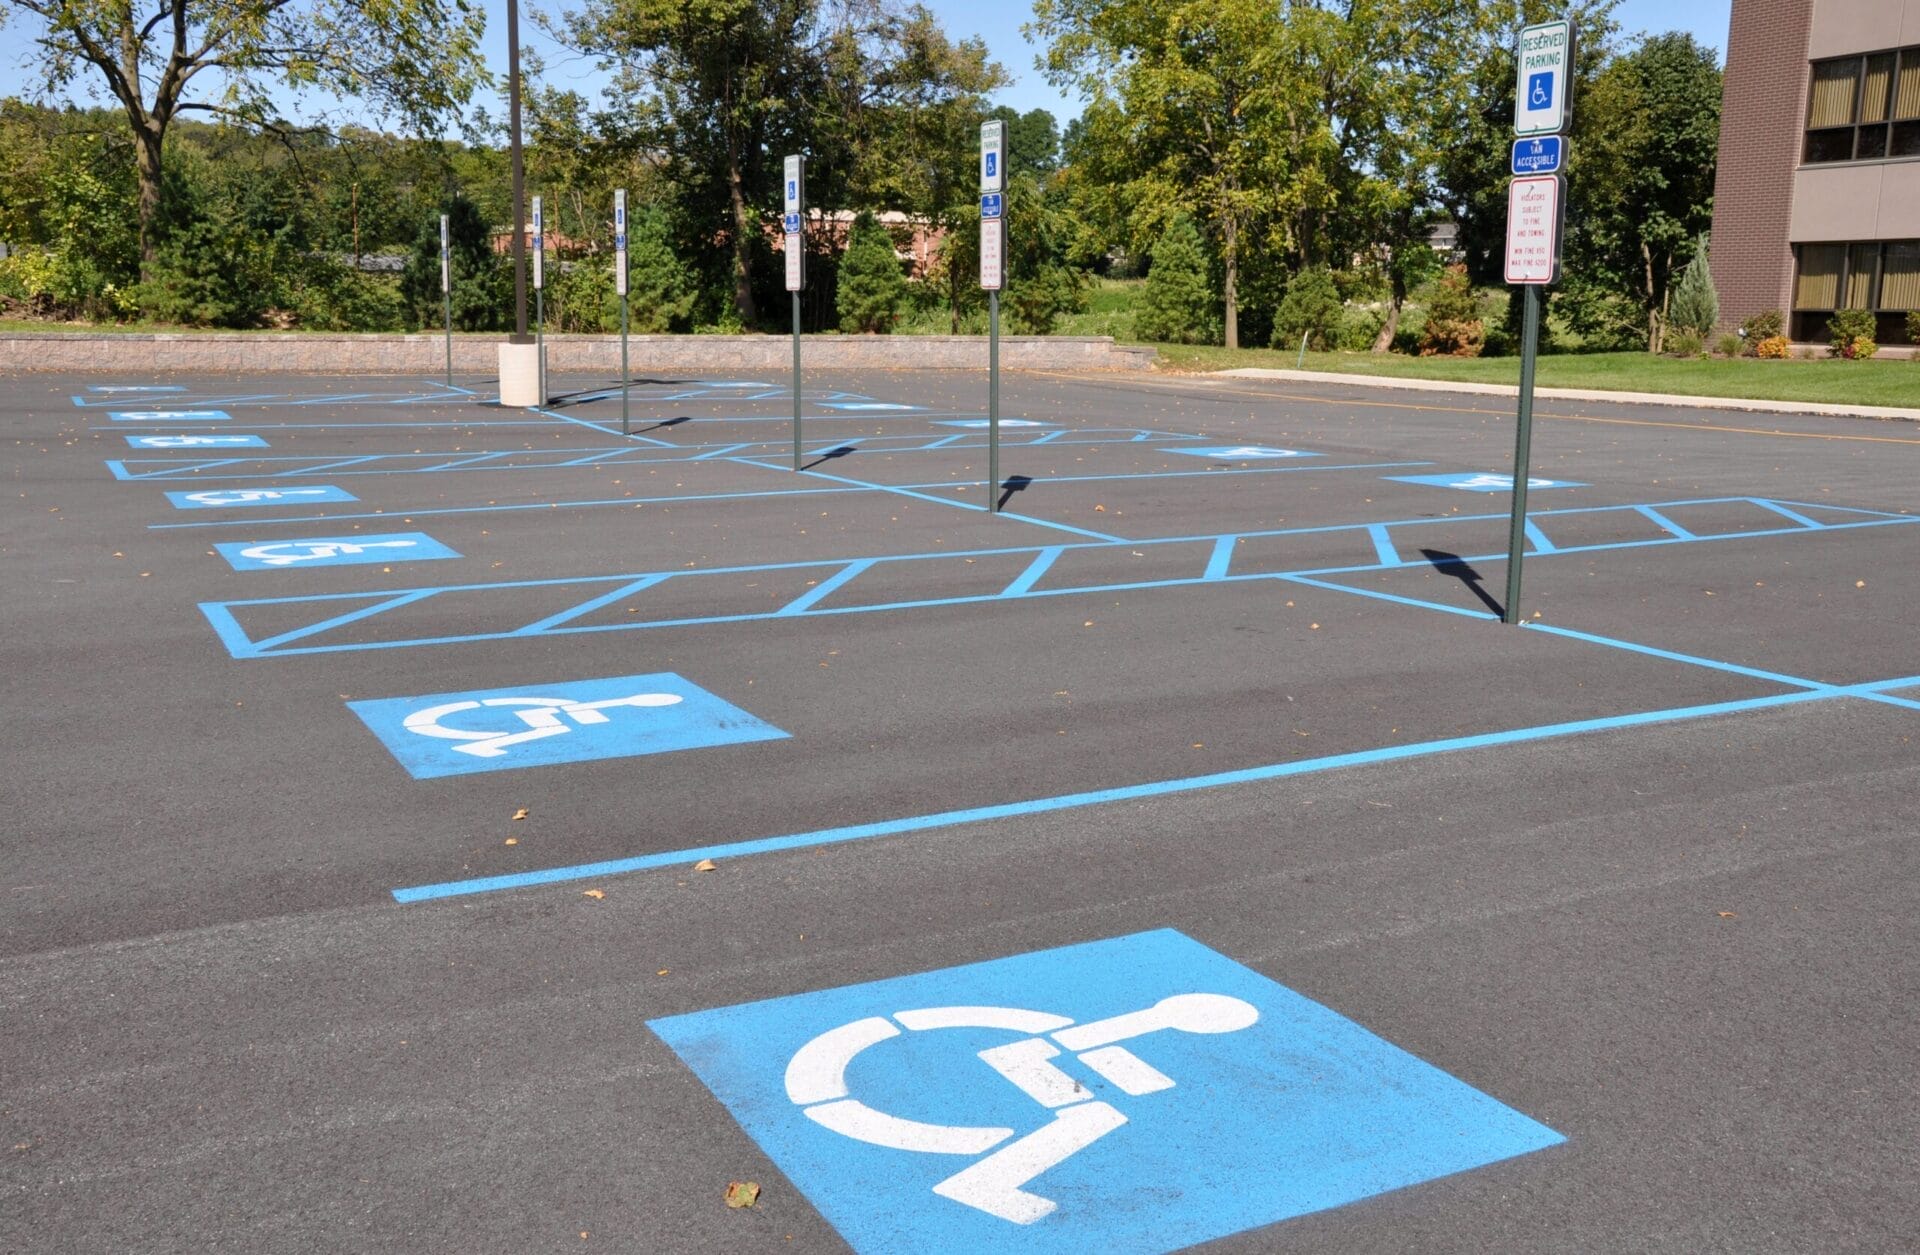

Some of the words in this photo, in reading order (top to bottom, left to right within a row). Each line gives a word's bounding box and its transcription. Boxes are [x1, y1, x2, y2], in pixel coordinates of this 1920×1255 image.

[1523, 33, 1564, 51] RESERVED
[1526, 52, 1561, 69] PARKING
[1530, 144, 1543, 155] VAN
[1517, 155, 1555, 167] ACCESSIBLE
